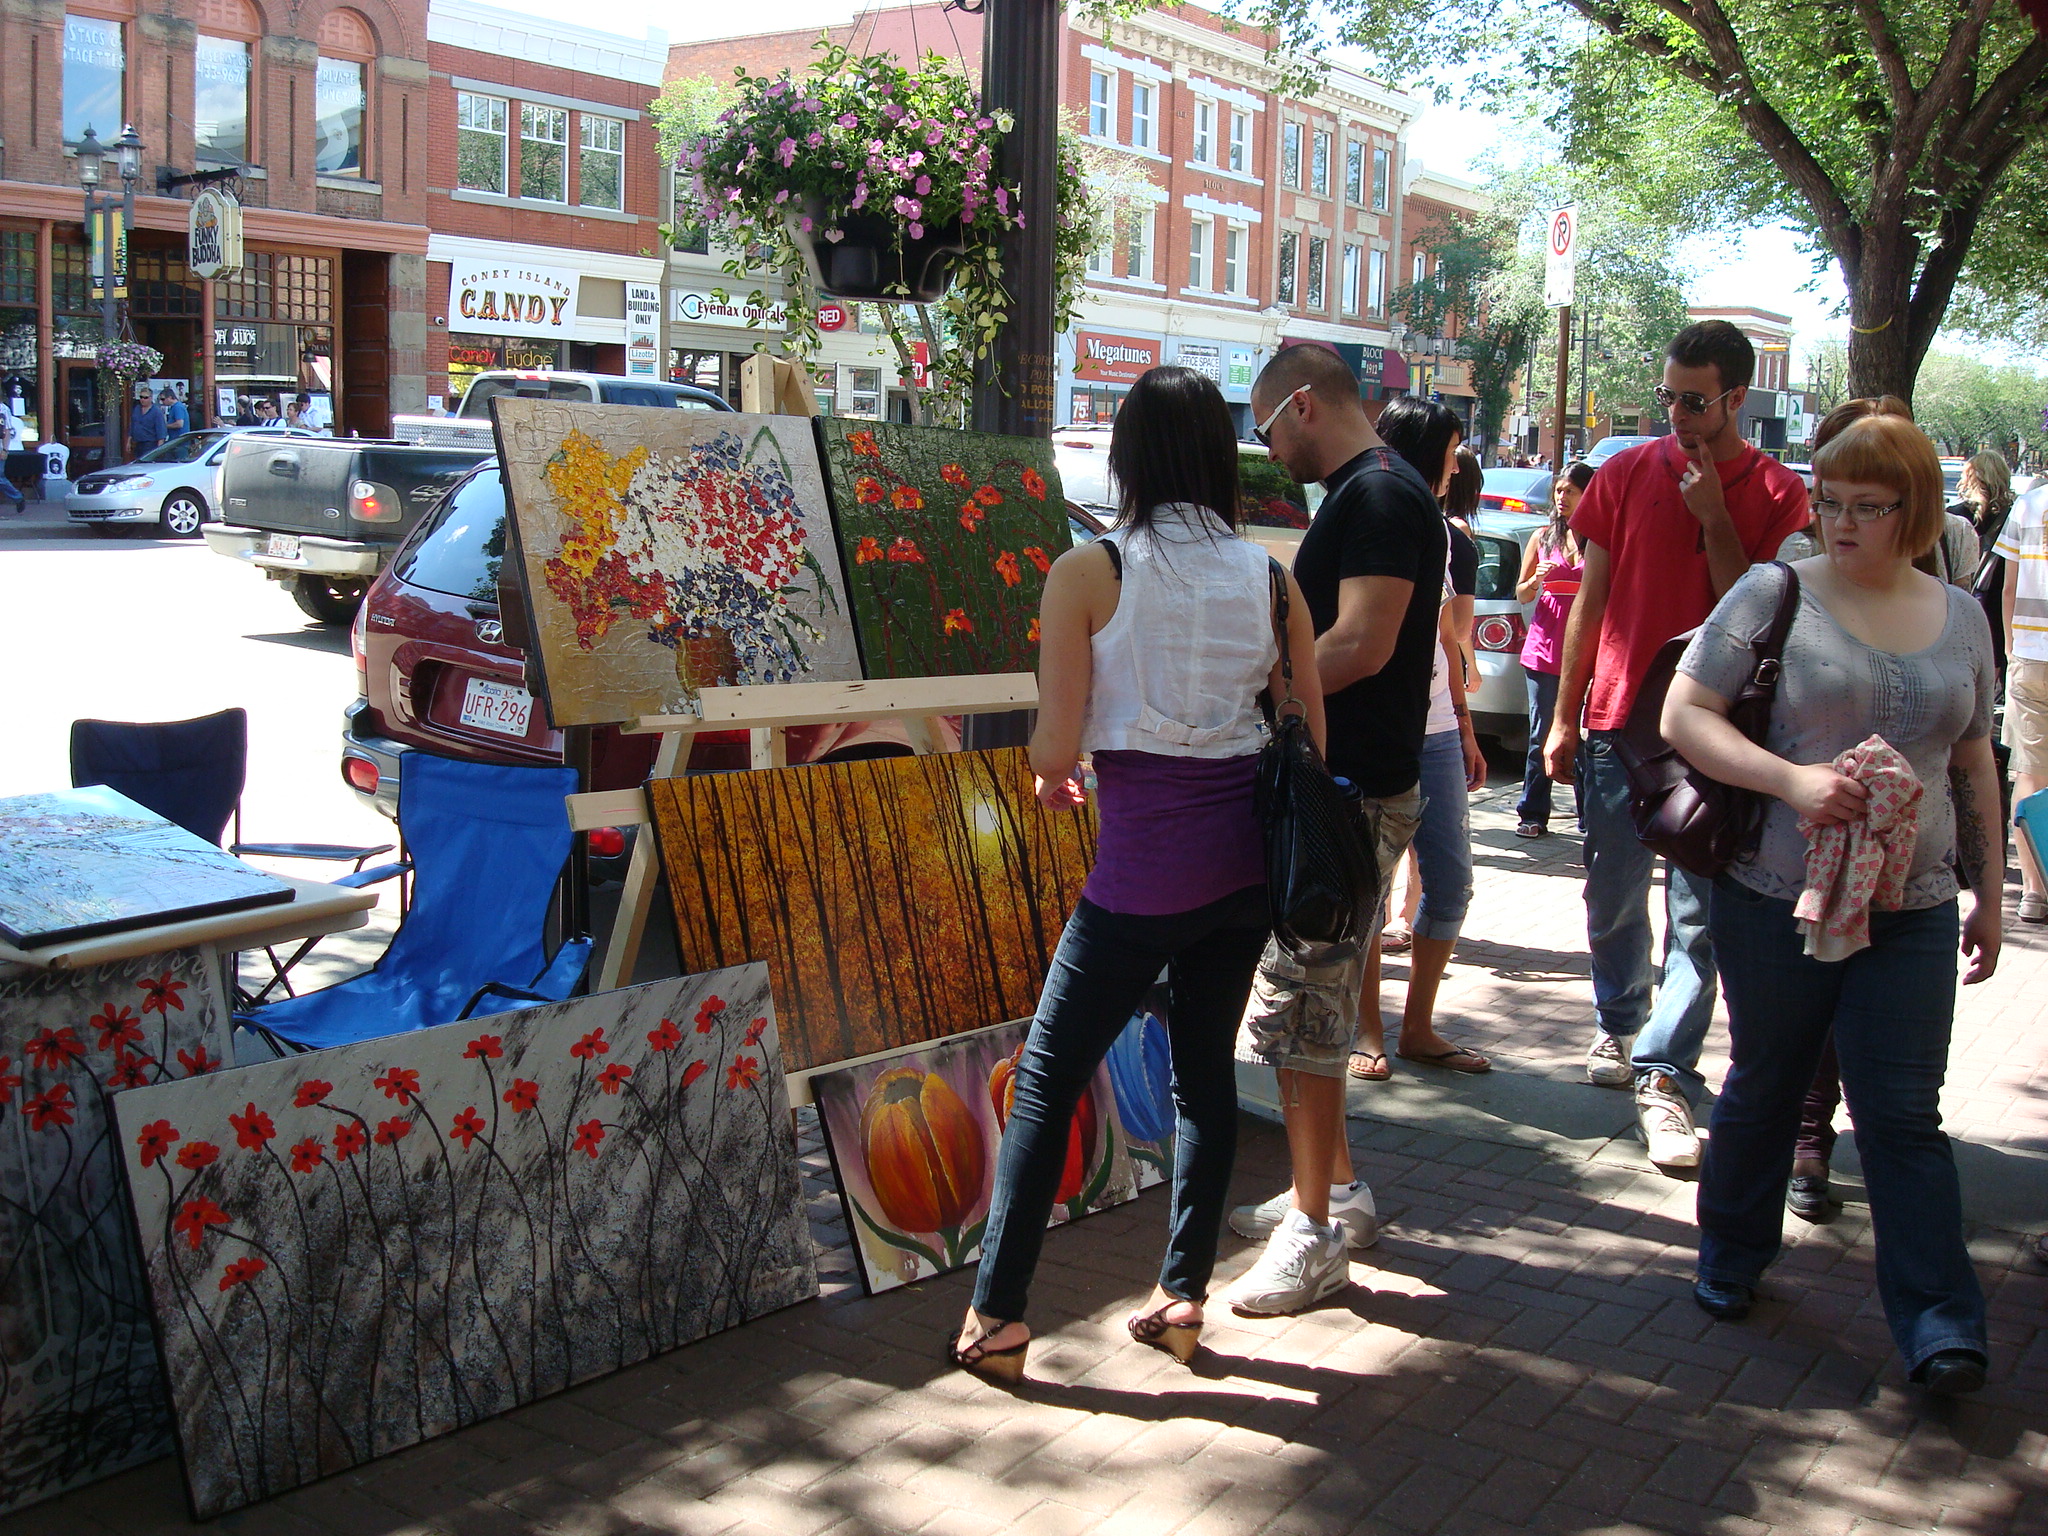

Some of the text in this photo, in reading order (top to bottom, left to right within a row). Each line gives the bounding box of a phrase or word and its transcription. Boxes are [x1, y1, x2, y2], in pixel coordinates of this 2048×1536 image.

[194, 225, 219, 247] FUNKY
[192, 243, 222, 267] BUDDHA
[461, 269, 571, 296] CONEY ISLAND
[631, 288, 656, 300] LAND &
[460, 288, 570, 326] CANDY
[628, 300, 660, 313] BUILDING
[697, 301, 786, 324] Eyemax Opticals
[635, 313, 652, 325] ONLY
[818, 309, 841, 324] RED
[449, 345, 554, 368] Candy Fudge
[631, 349, 655, 360] Lizotte
[1086, 338, 1152, 366] Megatunes
[1362, 346, 1384, 360] BLOCK
[1176, 355, 1199, 367] OFFICE
[1199, 356, 1220, 369] SPACE
[1365, 363, 1378, 375] 1912
[1196, 367, 1220, 380] EASE
